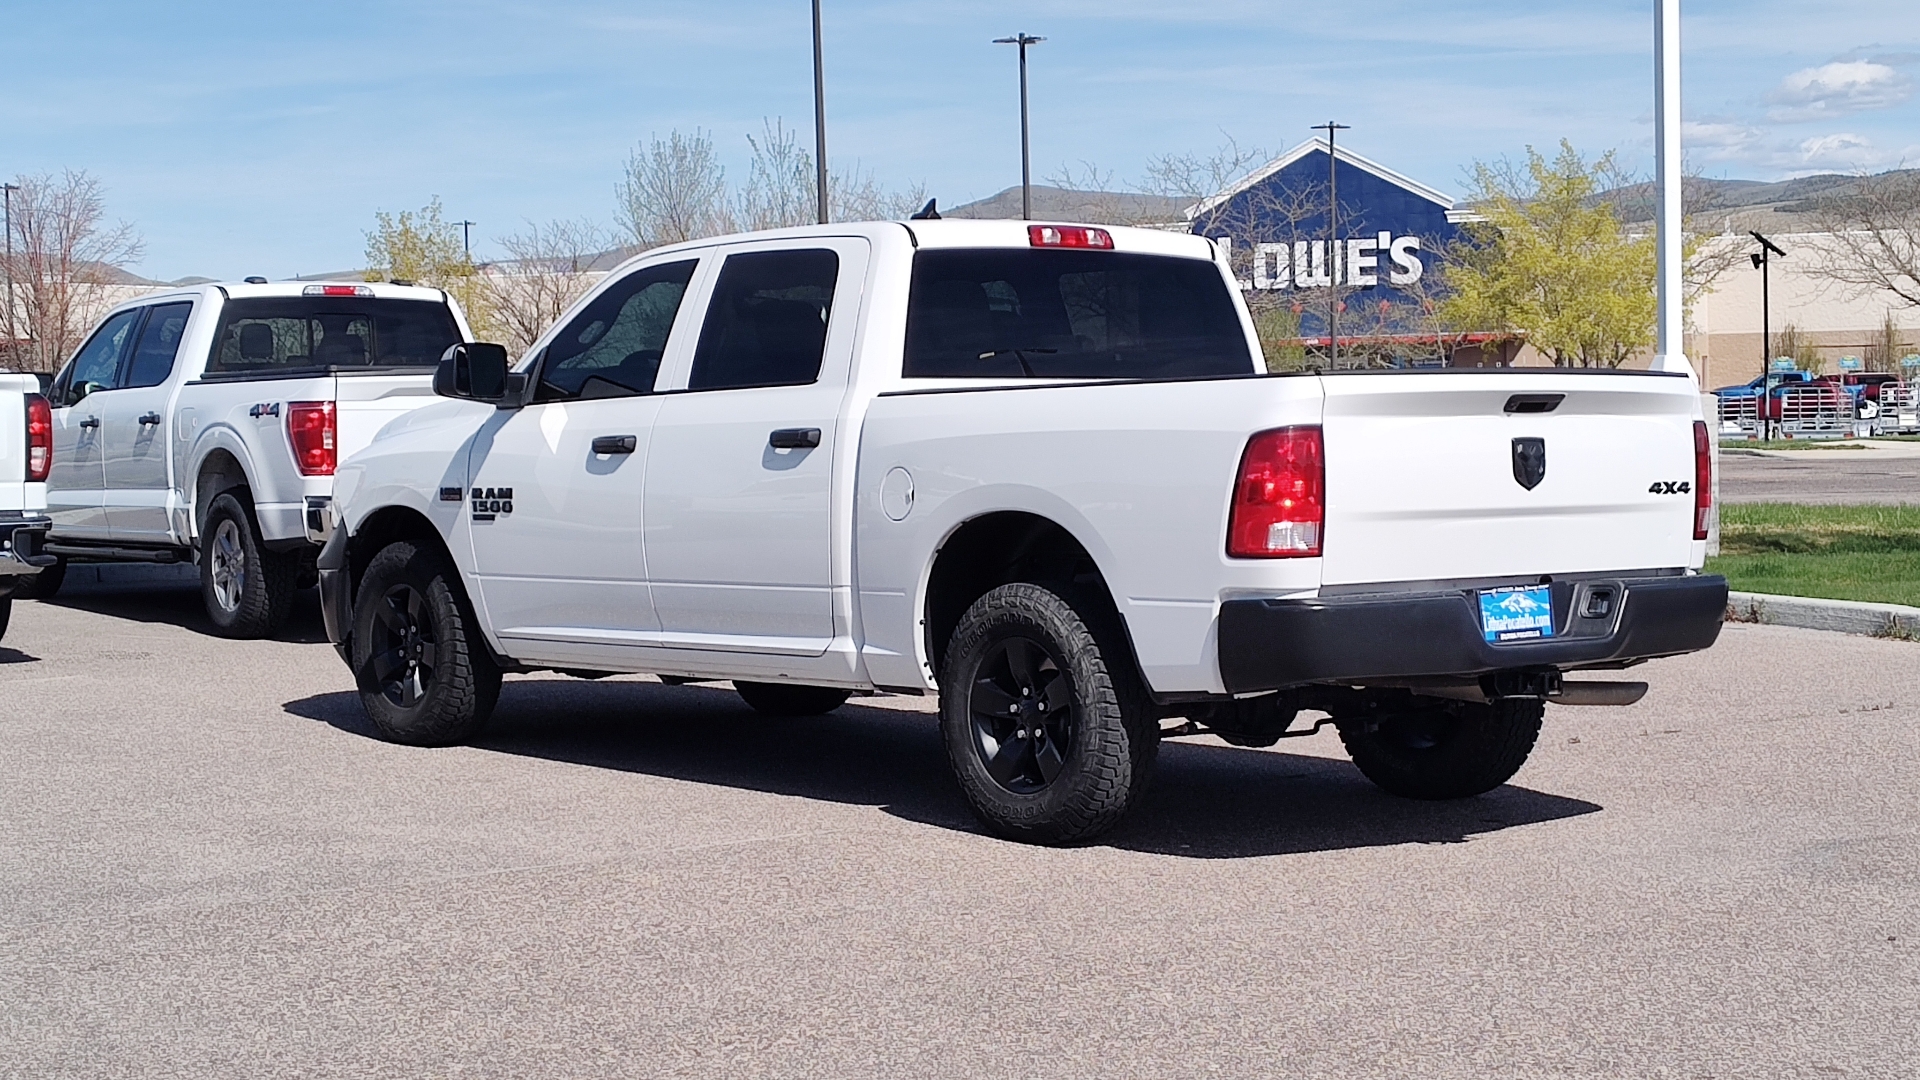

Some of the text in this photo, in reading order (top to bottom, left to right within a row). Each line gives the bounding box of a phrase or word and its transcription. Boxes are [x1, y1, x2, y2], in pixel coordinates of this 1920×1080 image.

[1217, 231, 1424, 290] LOWE'S
[471, 487, 513, 499] RAM
[471, 500, 513, 513] 1500
